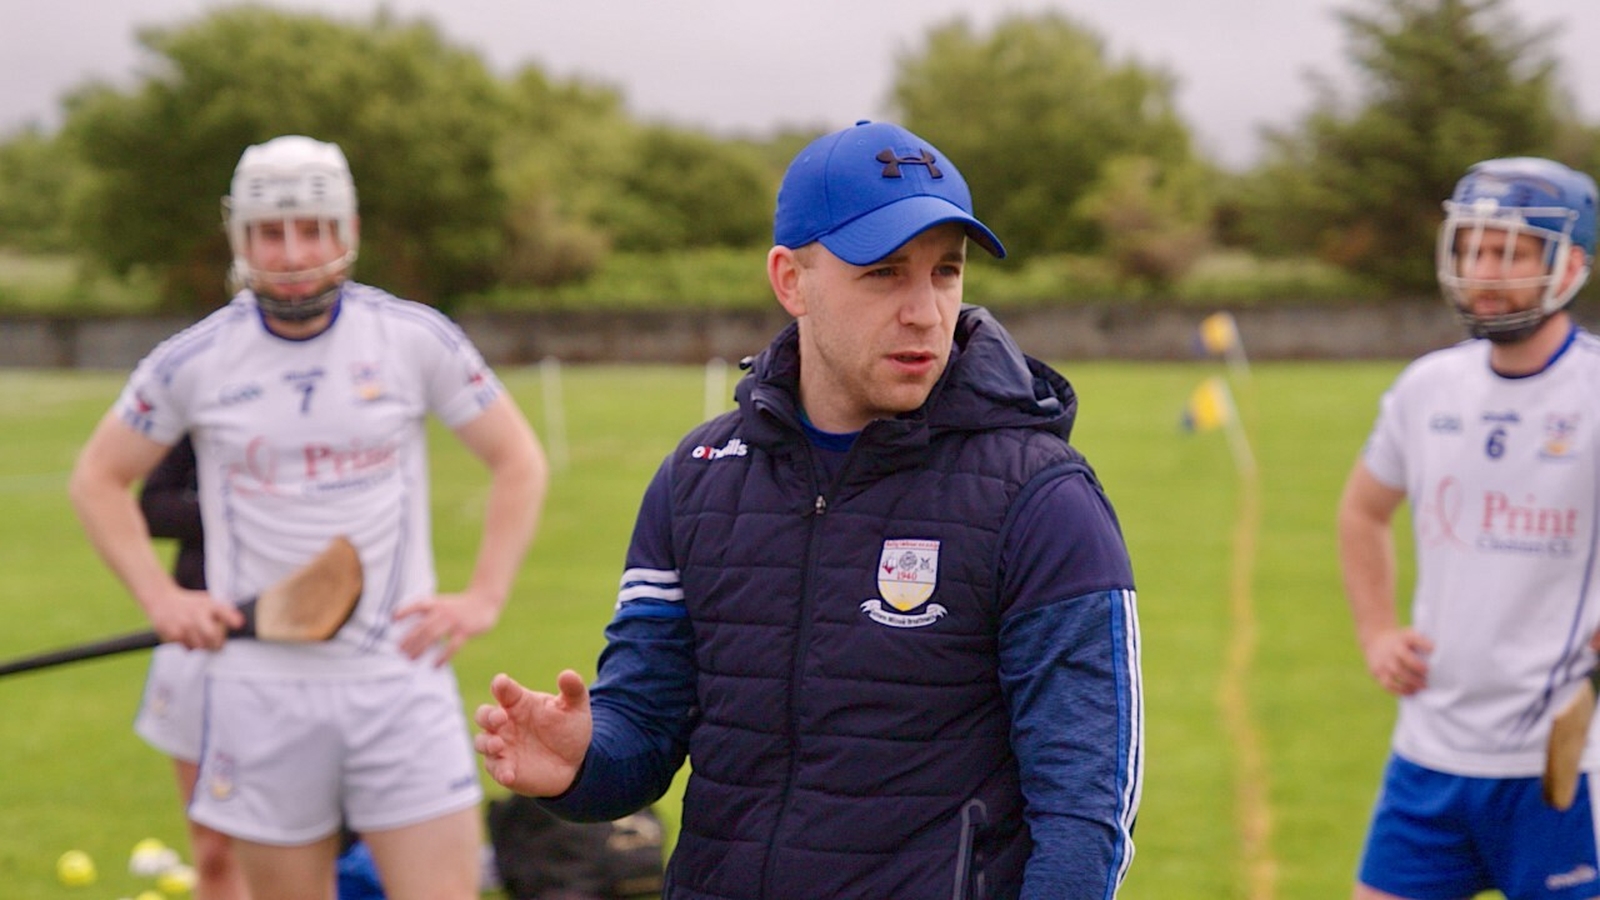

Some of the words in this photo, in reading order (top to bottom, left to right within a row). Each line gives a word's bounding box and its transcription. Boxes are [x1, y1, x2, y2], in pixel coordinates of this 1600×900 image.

[1486, 428, 1507, 460] 6
[1481, 490, 1578, 538] Print
[896, 570, 918, 581] 1940
